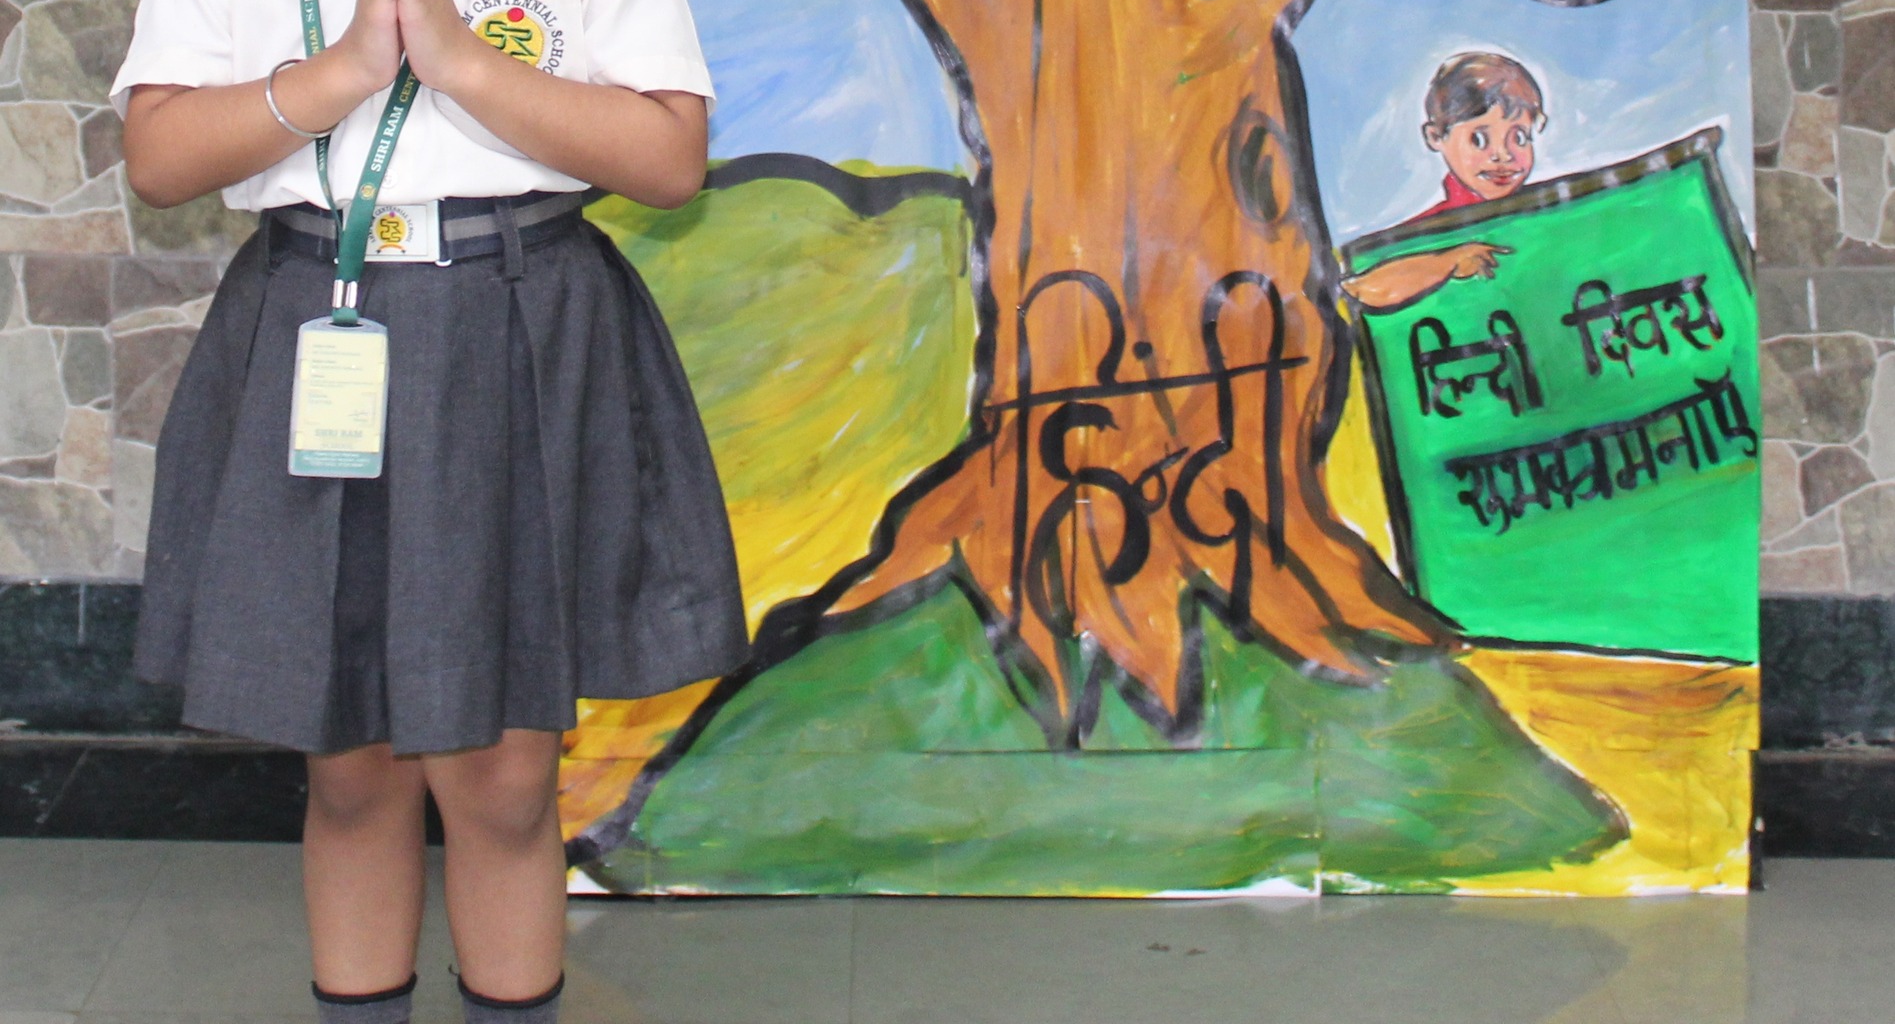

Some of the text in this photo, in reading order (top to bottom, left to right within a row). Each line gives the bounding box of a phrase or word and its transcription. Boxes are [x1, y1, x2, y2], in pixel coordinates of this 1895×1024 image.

[371, 106, 404, 173] SHRI RAM
[1560, 274, 1725, 378] दिवस
